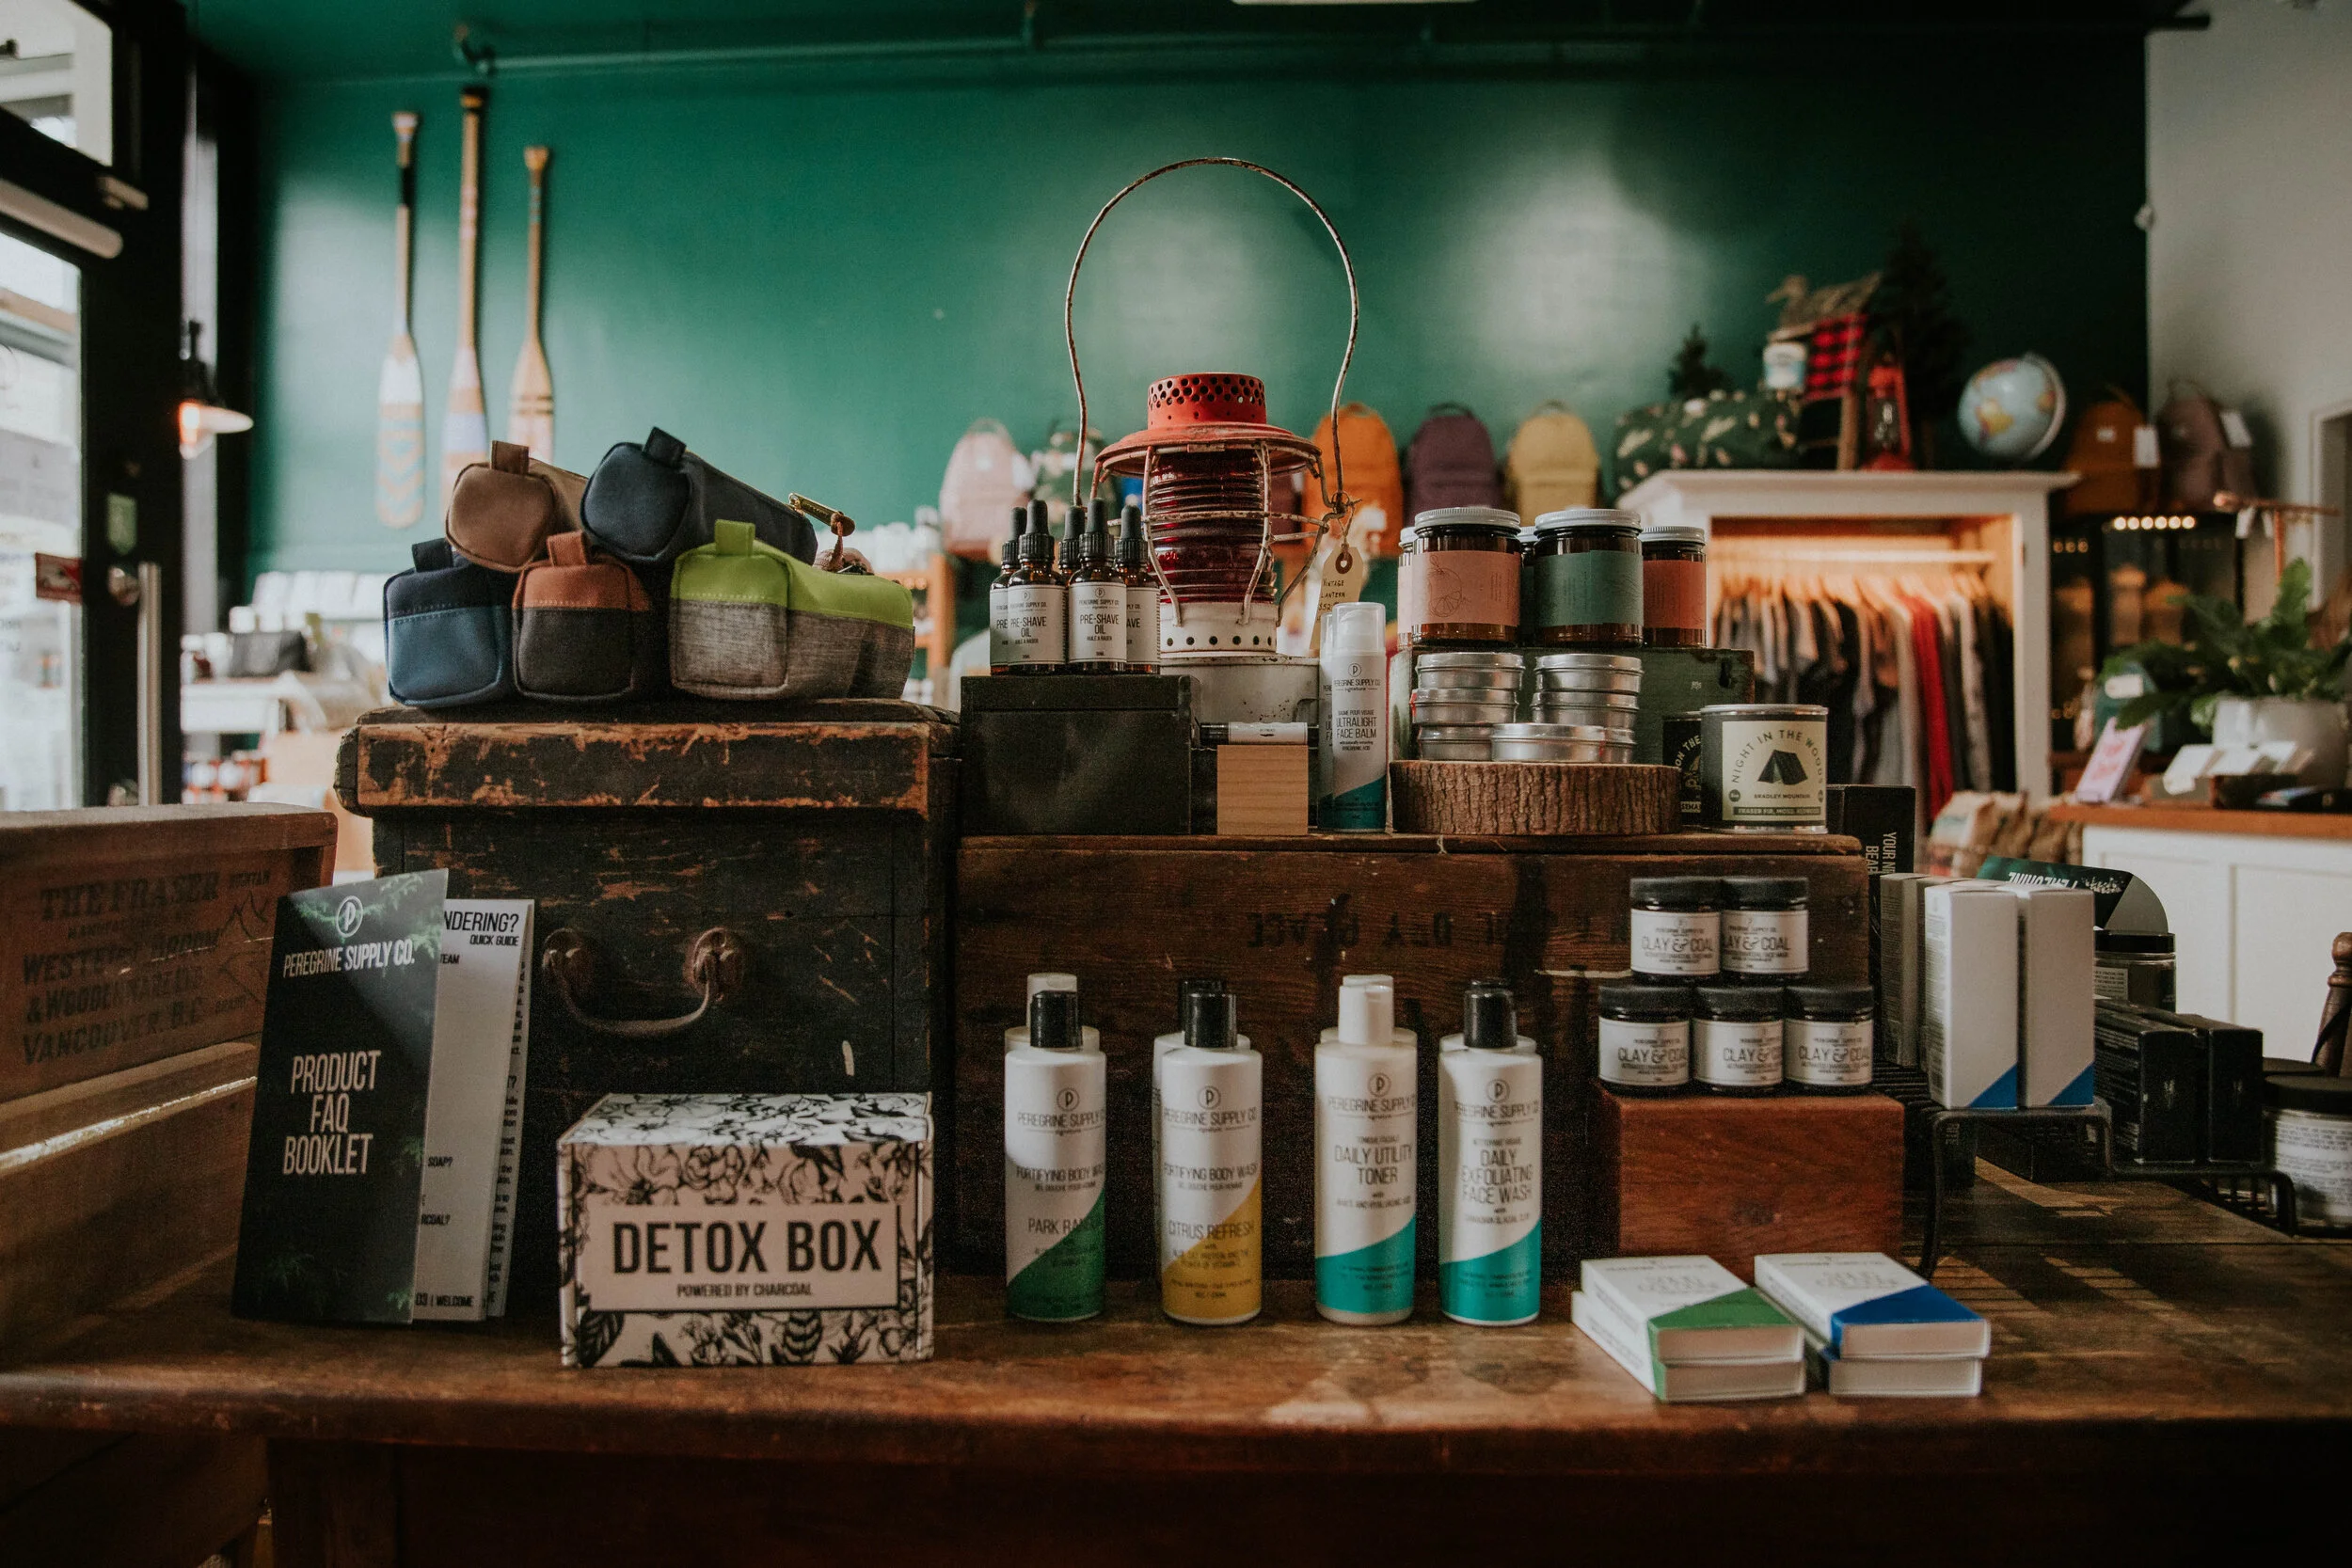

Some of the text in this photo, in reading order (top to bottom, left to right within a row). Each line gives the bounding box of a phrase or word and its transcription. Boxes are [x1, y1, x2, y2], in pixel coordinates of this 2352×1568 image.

[1323, 578, 1344, 588] VINTAGE
[1321, 591, 1346, 599] LANTERN
[1010, 616, 1047, 628] PRE-SHAVE
[1080, 613, 1120, 625] PRE-SHAVE
[1021, 627, 1032, 638] OIL
[1094, 624, 1106, 635] OIL
[1336, 717, 1377, 728] ULTRALIGHT
[1337, 728, 1376, 739] FACE BALM
[1732, 742, 1755, 784] NIGHT
[1757, 731, 1772, 744] IN
[1779, 729, 1804, 741] THE
[1883, 832, 1898, 860] YOUR
[469, 934, 519, 947] QUICK GUIDE
[1641, 937, 1672, 951] CLAY
[1760, 937, 1790, 951] COAL
[283, 939, 415, 978] PEREGRINE SUPPLY CO.
[1617, 1047, 1648, 1062] CLAY
[1723, 1046, 1756, 1063] CLAY
[1799, 1045, 1829, 1062] CLAY
[291, 1050, 381, 1094] PRODUCT
[310, 1092, 351, 1134] FAQ
[1210, 1109, 1246, 1126] SUPPLY
[283, 1133, 373, 1176] BOOKLET
[428, 1157, 453, 1167] SOAP?
[1334, 1144, 1412, 1165] DAILY UTILITY
[1480, 1149, 1517, 1166] DAILY
[1209, 1166, 1234, 1181] BODY
[1357, 1167, 1398, 1185] TONER
[1463, 1184, 1496, 1204] FACE
[1028, 1217, 1059, 1234] PARK
[1168, 1219, 1204, 1240] CITRUS
[613, 1219, 882, 1274] DETOX BOX
[676, 1282, 812, 1298] POWERED BY CHARCOAL
[437, 1294, 474, 1307] WELCOME
